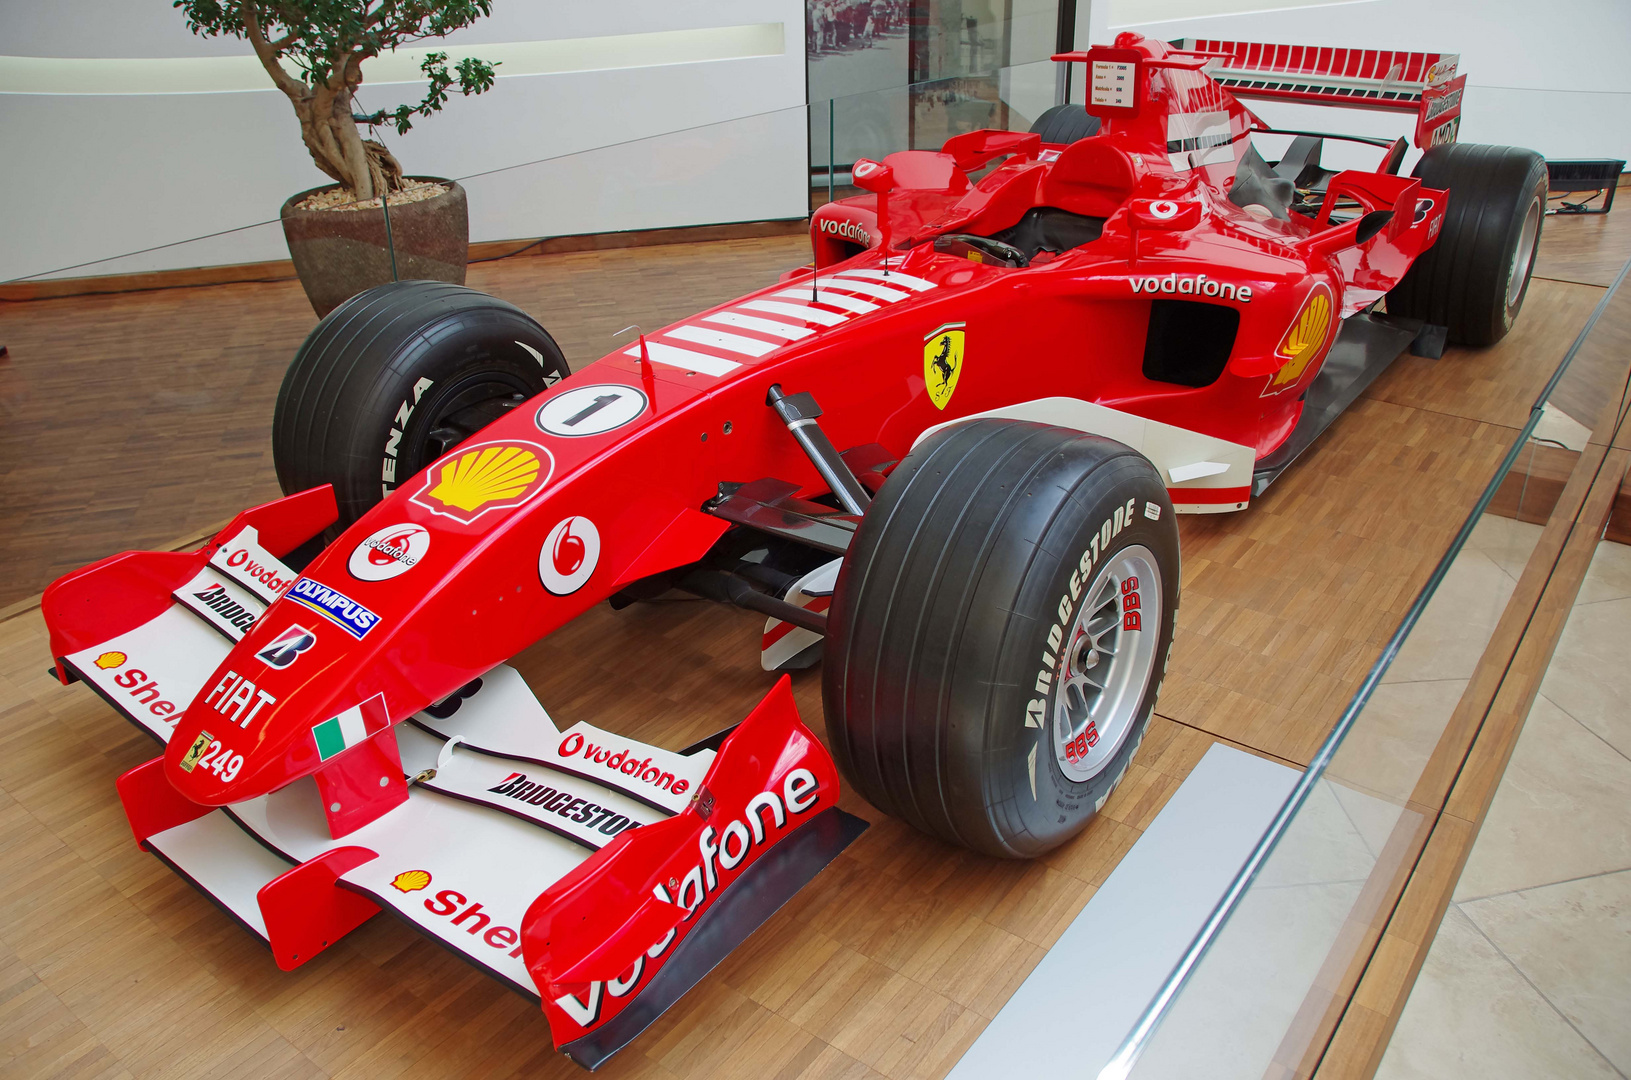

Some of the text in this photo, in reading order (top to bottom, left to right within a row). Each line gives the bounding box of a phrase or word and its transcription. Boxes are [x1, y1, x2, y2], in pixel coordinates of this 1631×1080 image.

[820, 218, 871, 248] vodafone
[1128, 272, 1252, 302] vodafone
[562, 393, 622, 427] 1
[364, 537, 416, 566] vodafone
[294, 580, 376, 629] OLYMPUS
[1025, 498, 1135, 729] BRIDGESTONE
[1121, 576, 1142, 631] BBS
[114, 669, 187, 729] Shel
[204, 670, 277, 729] FIAT
[198, 741, 244, 783] 249
[1065, 721, 1100, 765] BBS
[584, 743, 690, 795] vodafone
